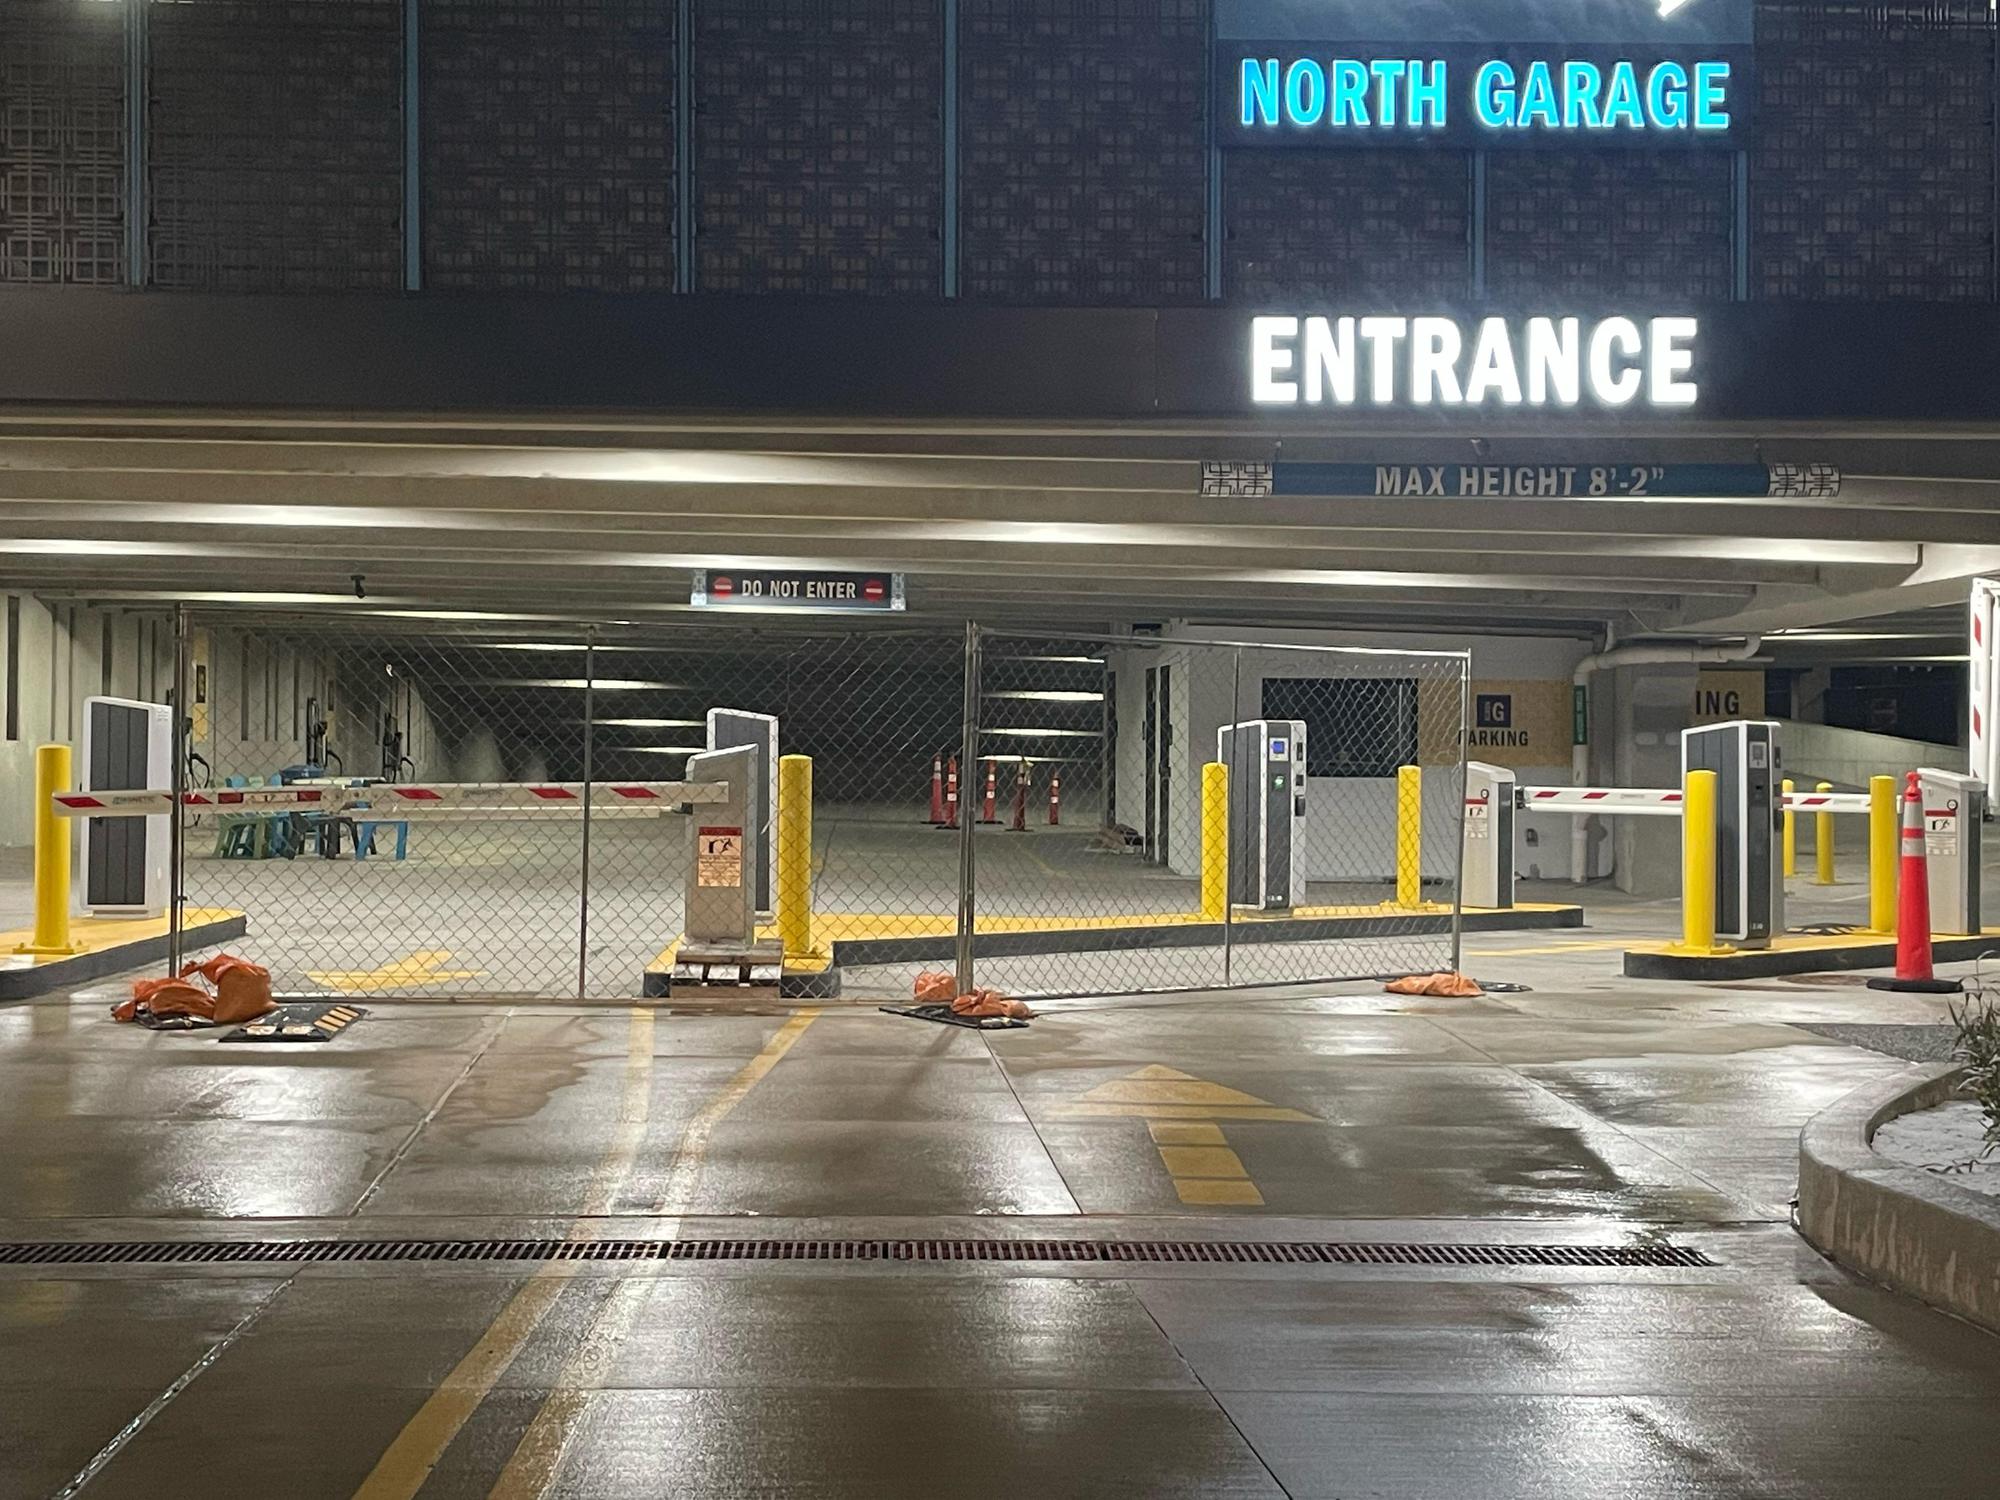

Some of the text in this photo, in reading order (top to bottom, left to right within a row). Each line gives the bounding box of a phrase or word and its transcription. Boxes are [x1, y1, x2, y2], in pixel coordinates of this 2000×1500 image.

[1240, 58, 1730, 131] NORTH GARAGE
[1250, 315, 1699, 406] ENTRANCE
[1375, 466, 1445, 496] MAX
[1459, 467, 1576, 496] HEIGHT
[741, 580, 856, 599] DO NOT ENTER
